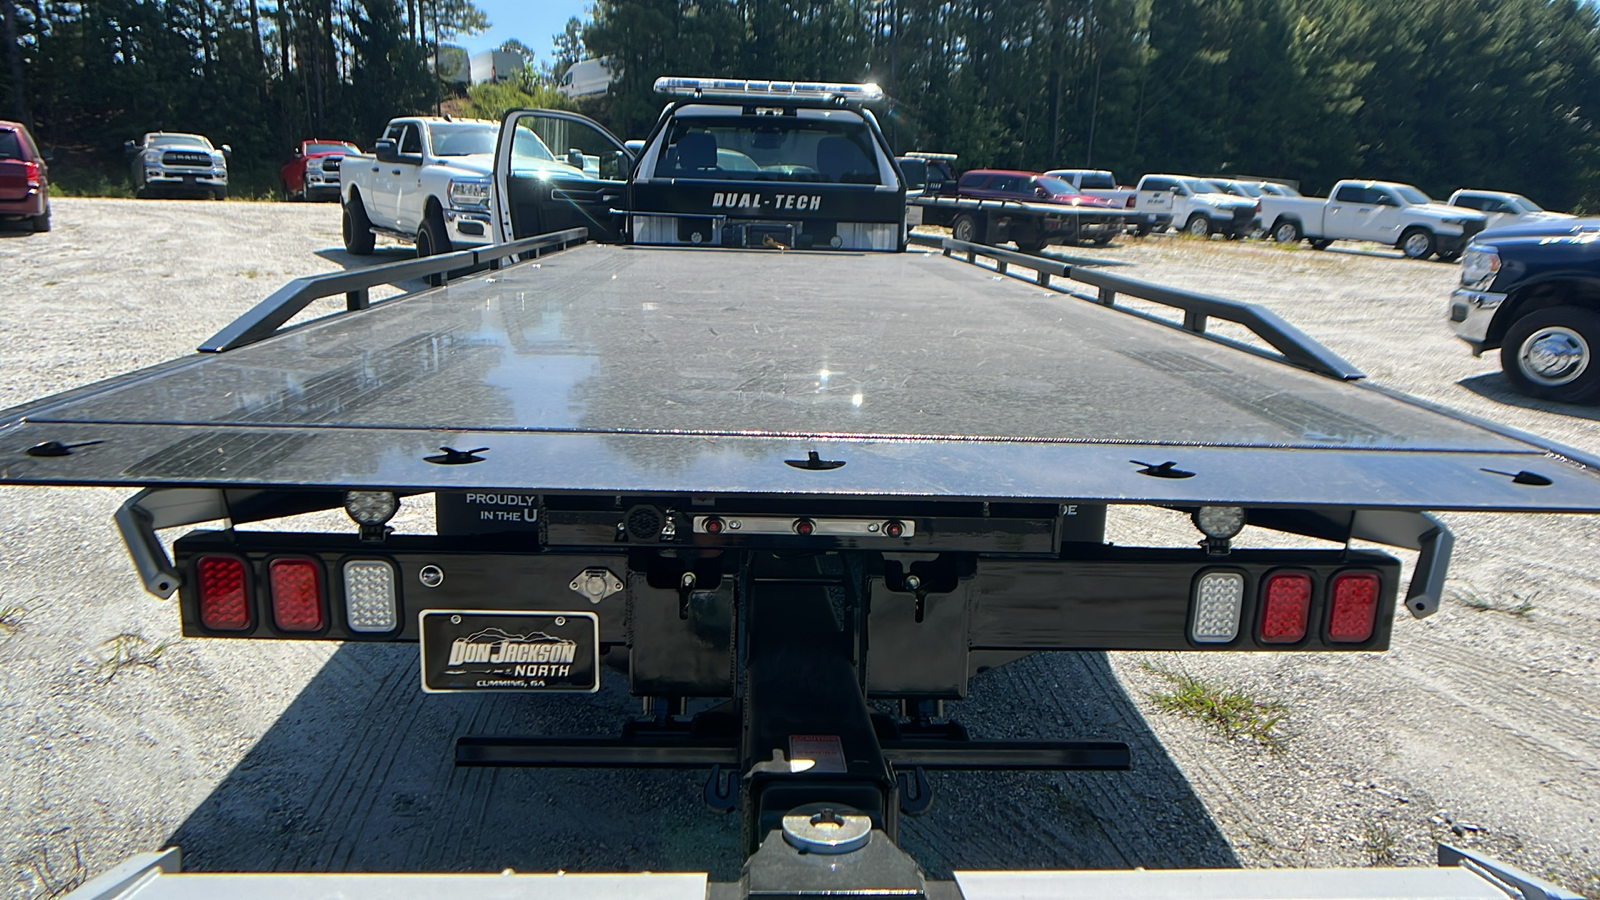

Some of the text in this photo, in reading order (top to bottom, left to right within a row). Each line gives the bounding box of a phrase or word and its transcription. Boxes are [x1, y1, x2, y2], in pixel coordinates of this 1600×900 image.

[712, 193, 822, 211] DUAL-TECH
[466, 493, 535, 506] PROUDLY
[480, 510, 494, 520] IN
[496, 511, 521, 522] THE
[490, 640, 577, 664] JACKSON
[514, 664, 571, 677] NORTH
[476, 680, 529, 688] CUMMING,
